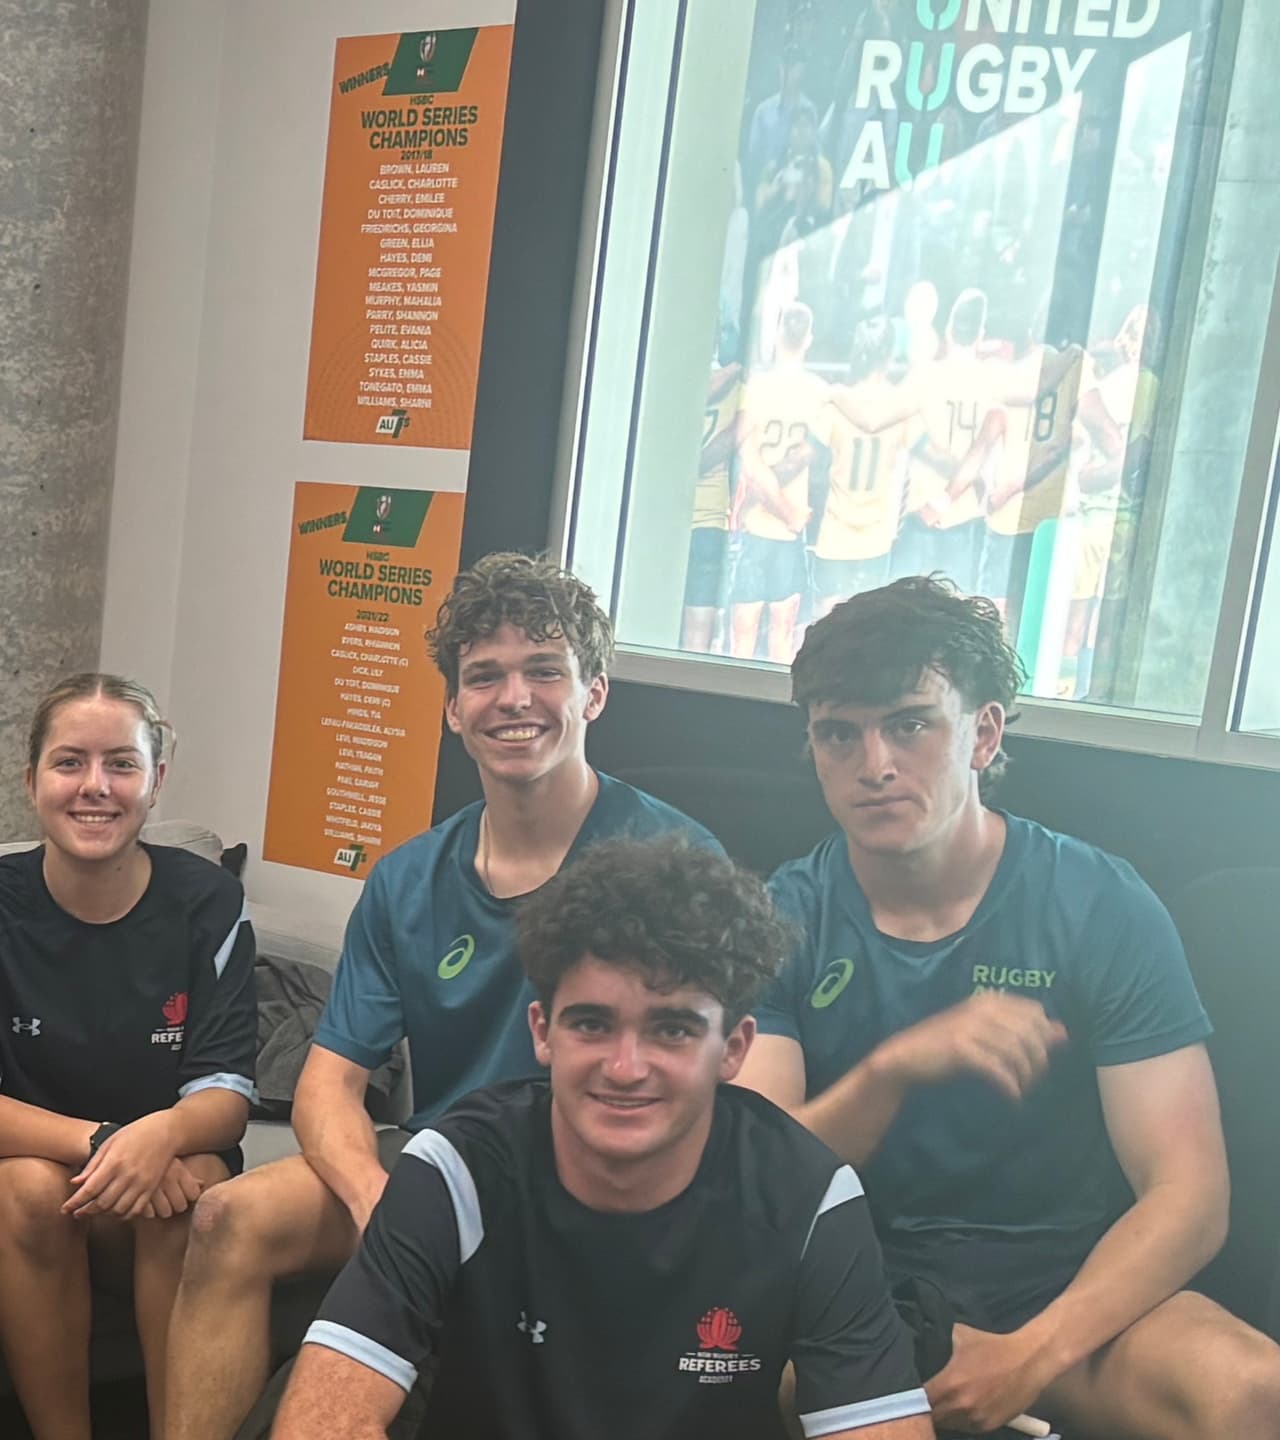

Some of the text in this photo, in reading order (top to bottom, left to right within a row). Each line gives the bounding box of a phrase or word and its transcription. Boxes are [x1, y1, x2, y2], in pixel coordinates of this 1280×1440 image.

[340, 62, 391, 95] WINNERS
[855, 39, 1097, 114] RUGBY
[361, 105, 477, 128] WORLD SERIES
[369, 127, 467, 149] CHAMPIONS
[839, 120, 944, 192] AU
[298, 511, 347, 536] WINNERS
[319, 558, 431, 586] WORLD SERIES
[327, 579, 422, 605] CHAMPIONS
[973, 965, 1056, 988] RUGBY
[678, 1357, 761, 1373] REFEREES
